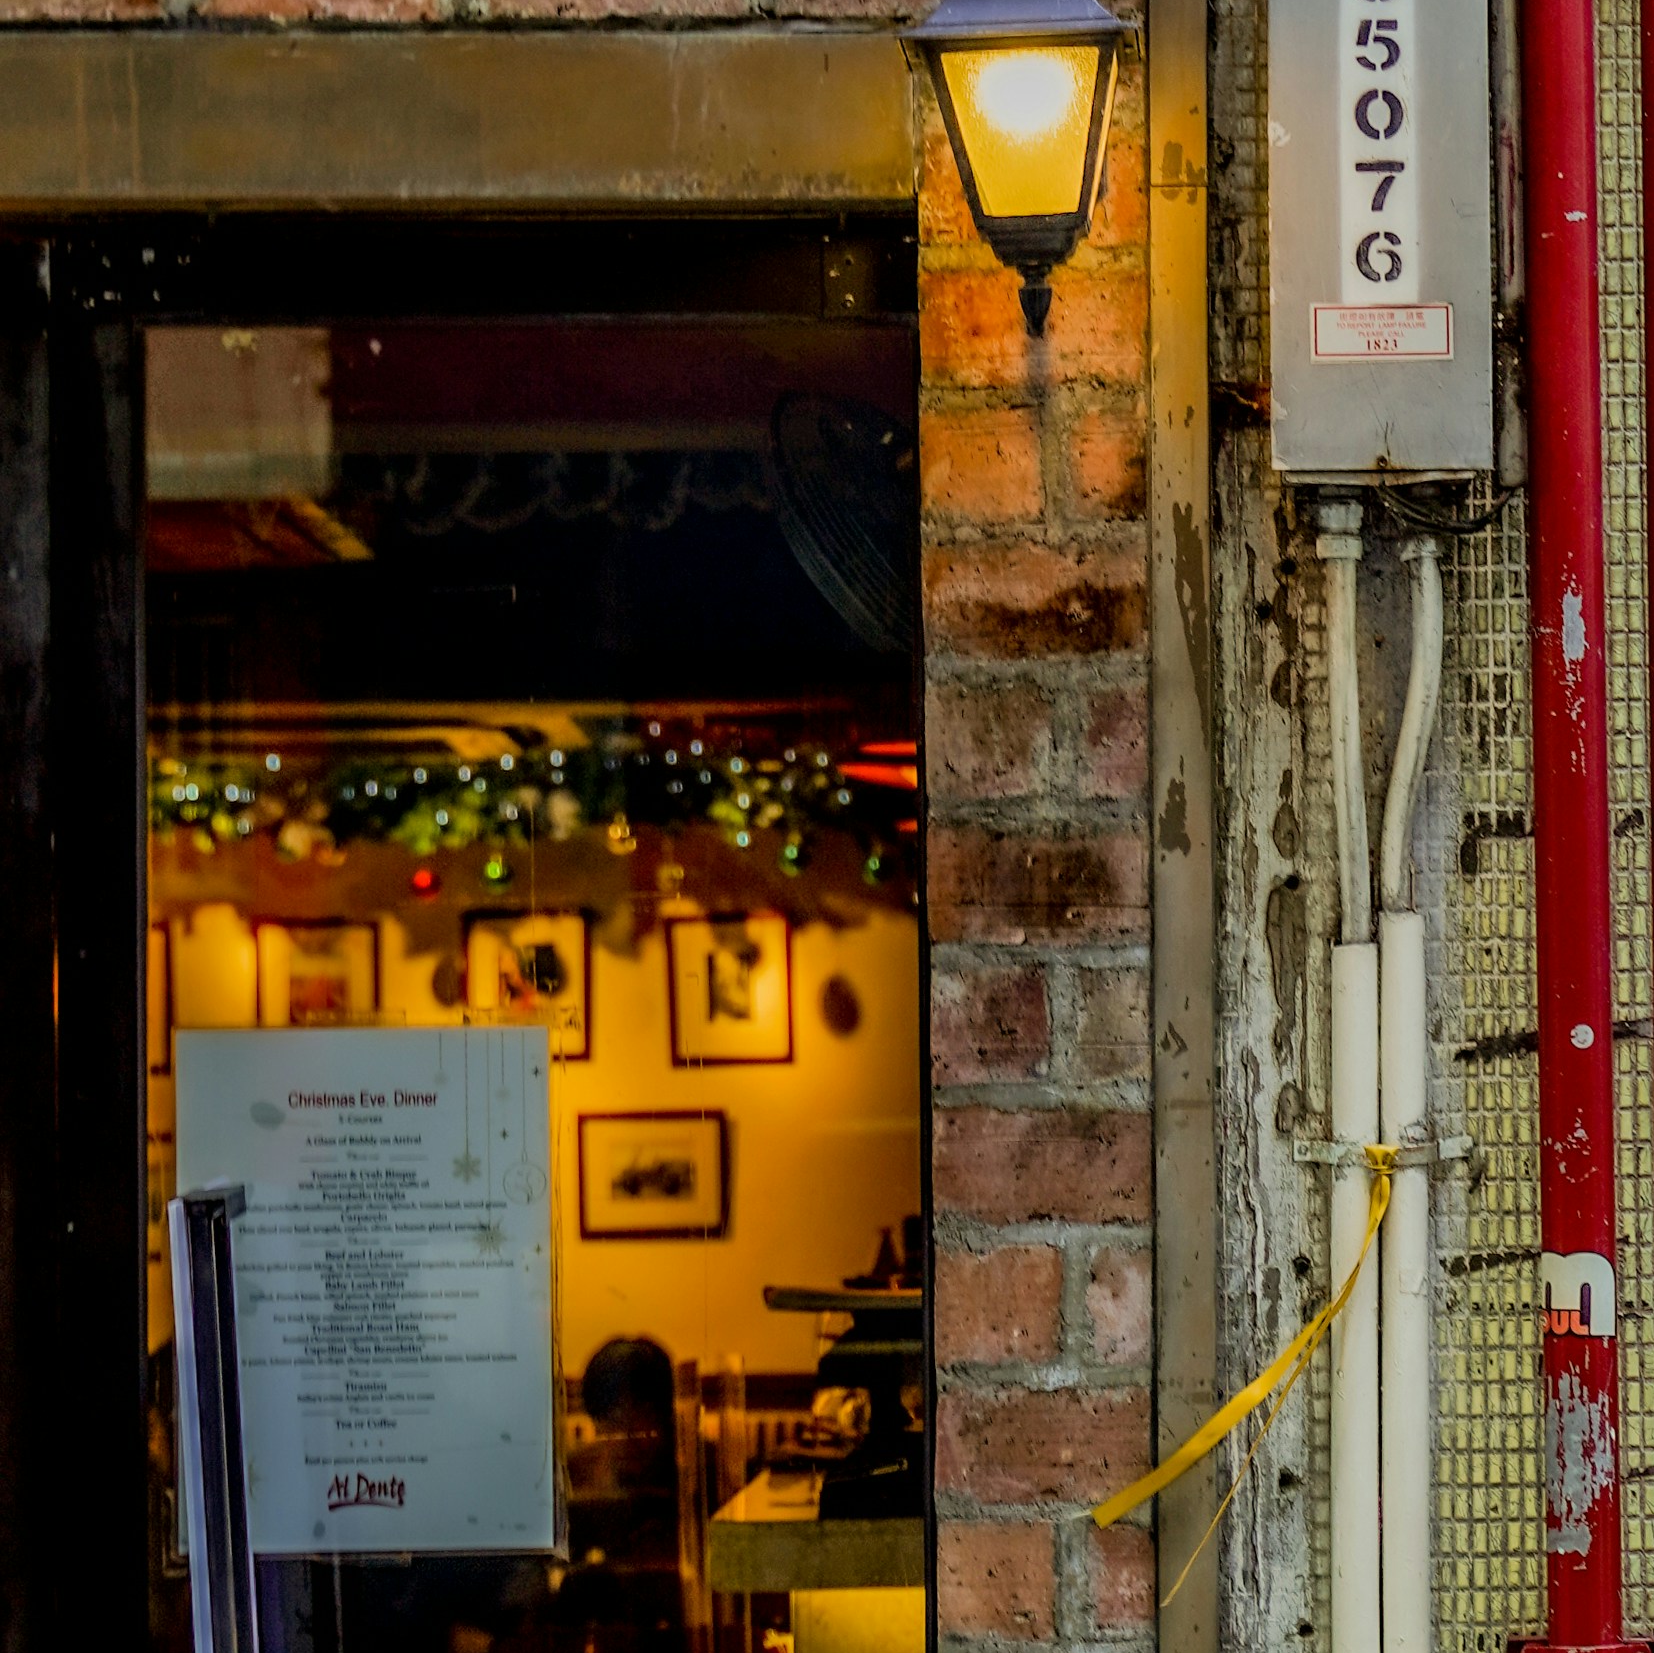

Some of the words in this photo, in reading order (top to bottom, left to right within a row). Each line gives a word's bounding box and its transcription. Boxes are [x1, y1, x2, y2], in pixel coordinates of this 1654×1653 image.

[1358, 330, 1385, 338] PLEASE
[1387, 330, 1405, 338] CALL
[1366, 339, 1399, 352] 1823
[288, 1091, 356, 1109] Christmas
[393, 1090, 439, 1108] Dinner
[305, 1136, 313, 1146] A
[340, 1135, 348, 1146] of
[393, 1134, 422, 1146] Arrival
[311, 1169, 347, 1182] Tomato
[325, 1250, 346, 1261] Beef
[350, 1250, 366, 1261] and
[368, 1249, 404, 1261] Lobster
[325, 1280, 347, 1292] Baby
[350, 1280, 378, 1291] Lamb
[380, 1280, 405, 1290] Fillet
[371, 1301, 396, 1312] Fillet
[311, 1322, 364, 1334] Traditional
[366, 1323, 394, 1333] Roast
[396, 1322, 419, 1333] Ham
[335, 1420, 353, 1431] Tea
[354, 1421, 365, 1430] or
[366, 1419, 398, 1430] Coffee
[353, 1472, 407, 1507] Dente
